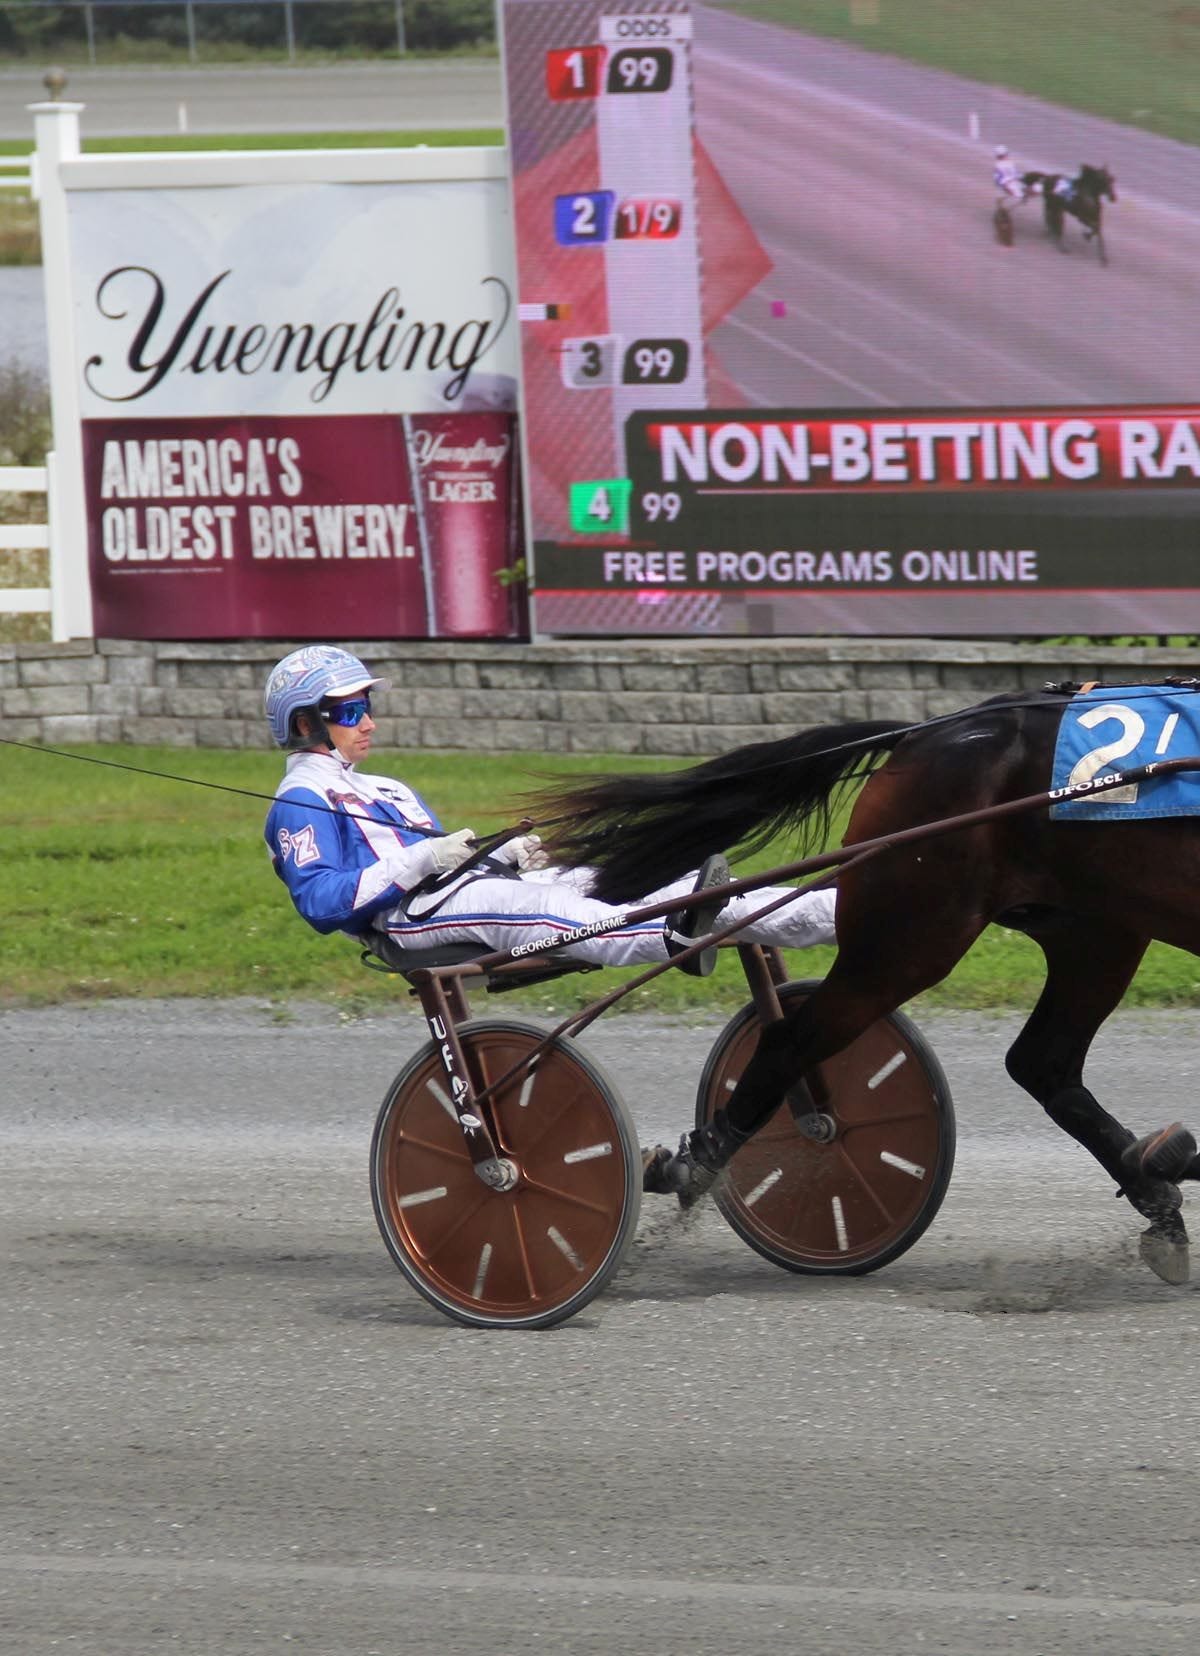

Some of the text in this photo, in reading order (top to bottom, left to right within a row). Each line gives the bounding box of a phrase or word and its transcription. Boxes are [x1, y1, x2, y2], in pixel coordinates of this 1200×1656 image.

[617, 20, 671, 37] ODDS
[565, 53, 658, 88] 1 99
[572, 198, 674, 235] 2 1/9
[84, 266, 512, 402] Yuengling
[580, 343, 674, 377] 3 99
[101, 438, 302, 499] AMERICA'S
[660, 420, 1100, 482] NON-BETTING
[428, 481, 497, 502] LAGER
[588, 482, 682, 521] 4 99
[102, 504, 415, 561] OLDEST BREWERY.
[603, 550, 1038, 583] FREE PROGRAMS ONLINE
[511, 914, 628, 958] GEORGE DUCHARME
